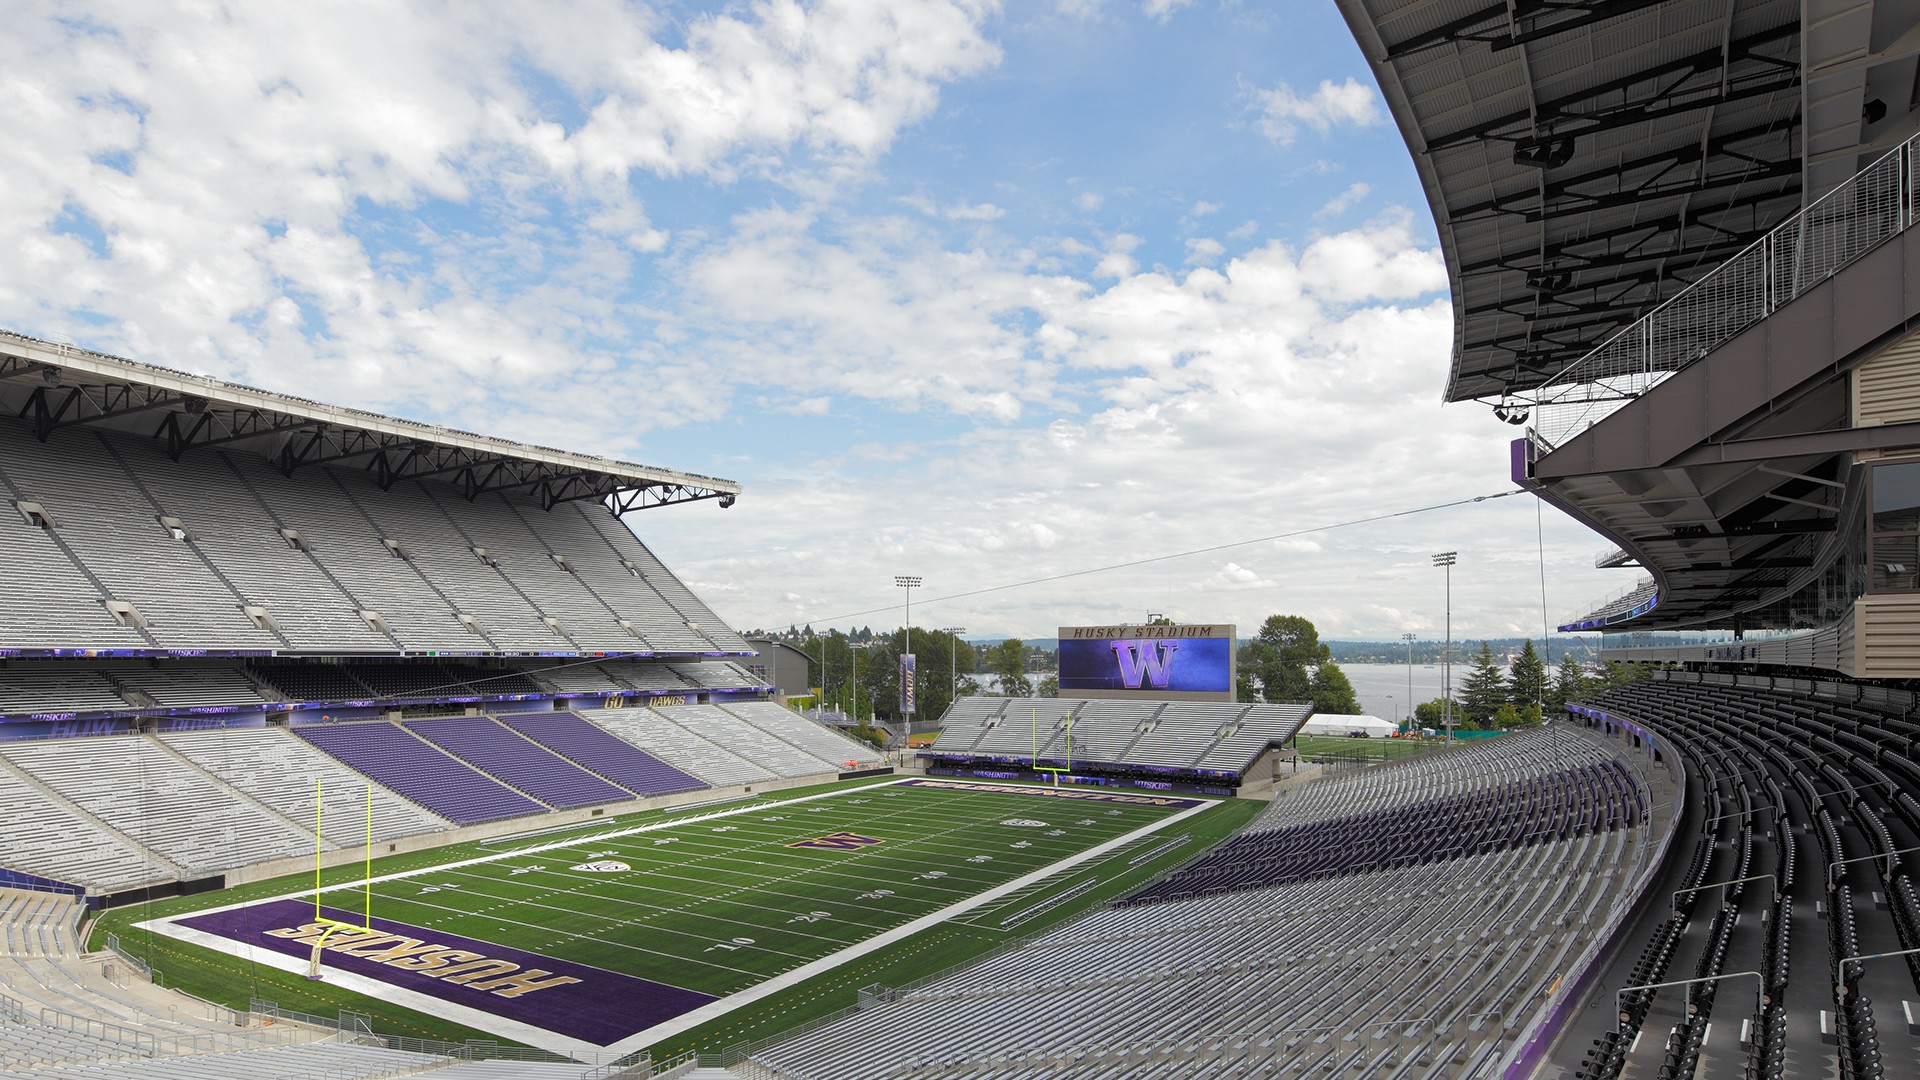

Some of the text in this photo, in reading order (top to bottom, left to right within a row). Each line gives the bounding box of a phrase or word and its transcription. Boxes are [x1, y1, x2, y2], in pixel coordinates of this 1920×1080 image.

[1073, 626, 1212, 638] HUSKY STADIUM
[1110, 639, 1178, 688] W
[604, 695, 685, 709] GO DAWGS
[795, 911, 832, 923] 20
[714, 937, 756, 952] 10
[262, 922, 584, 999] HUSKIES
